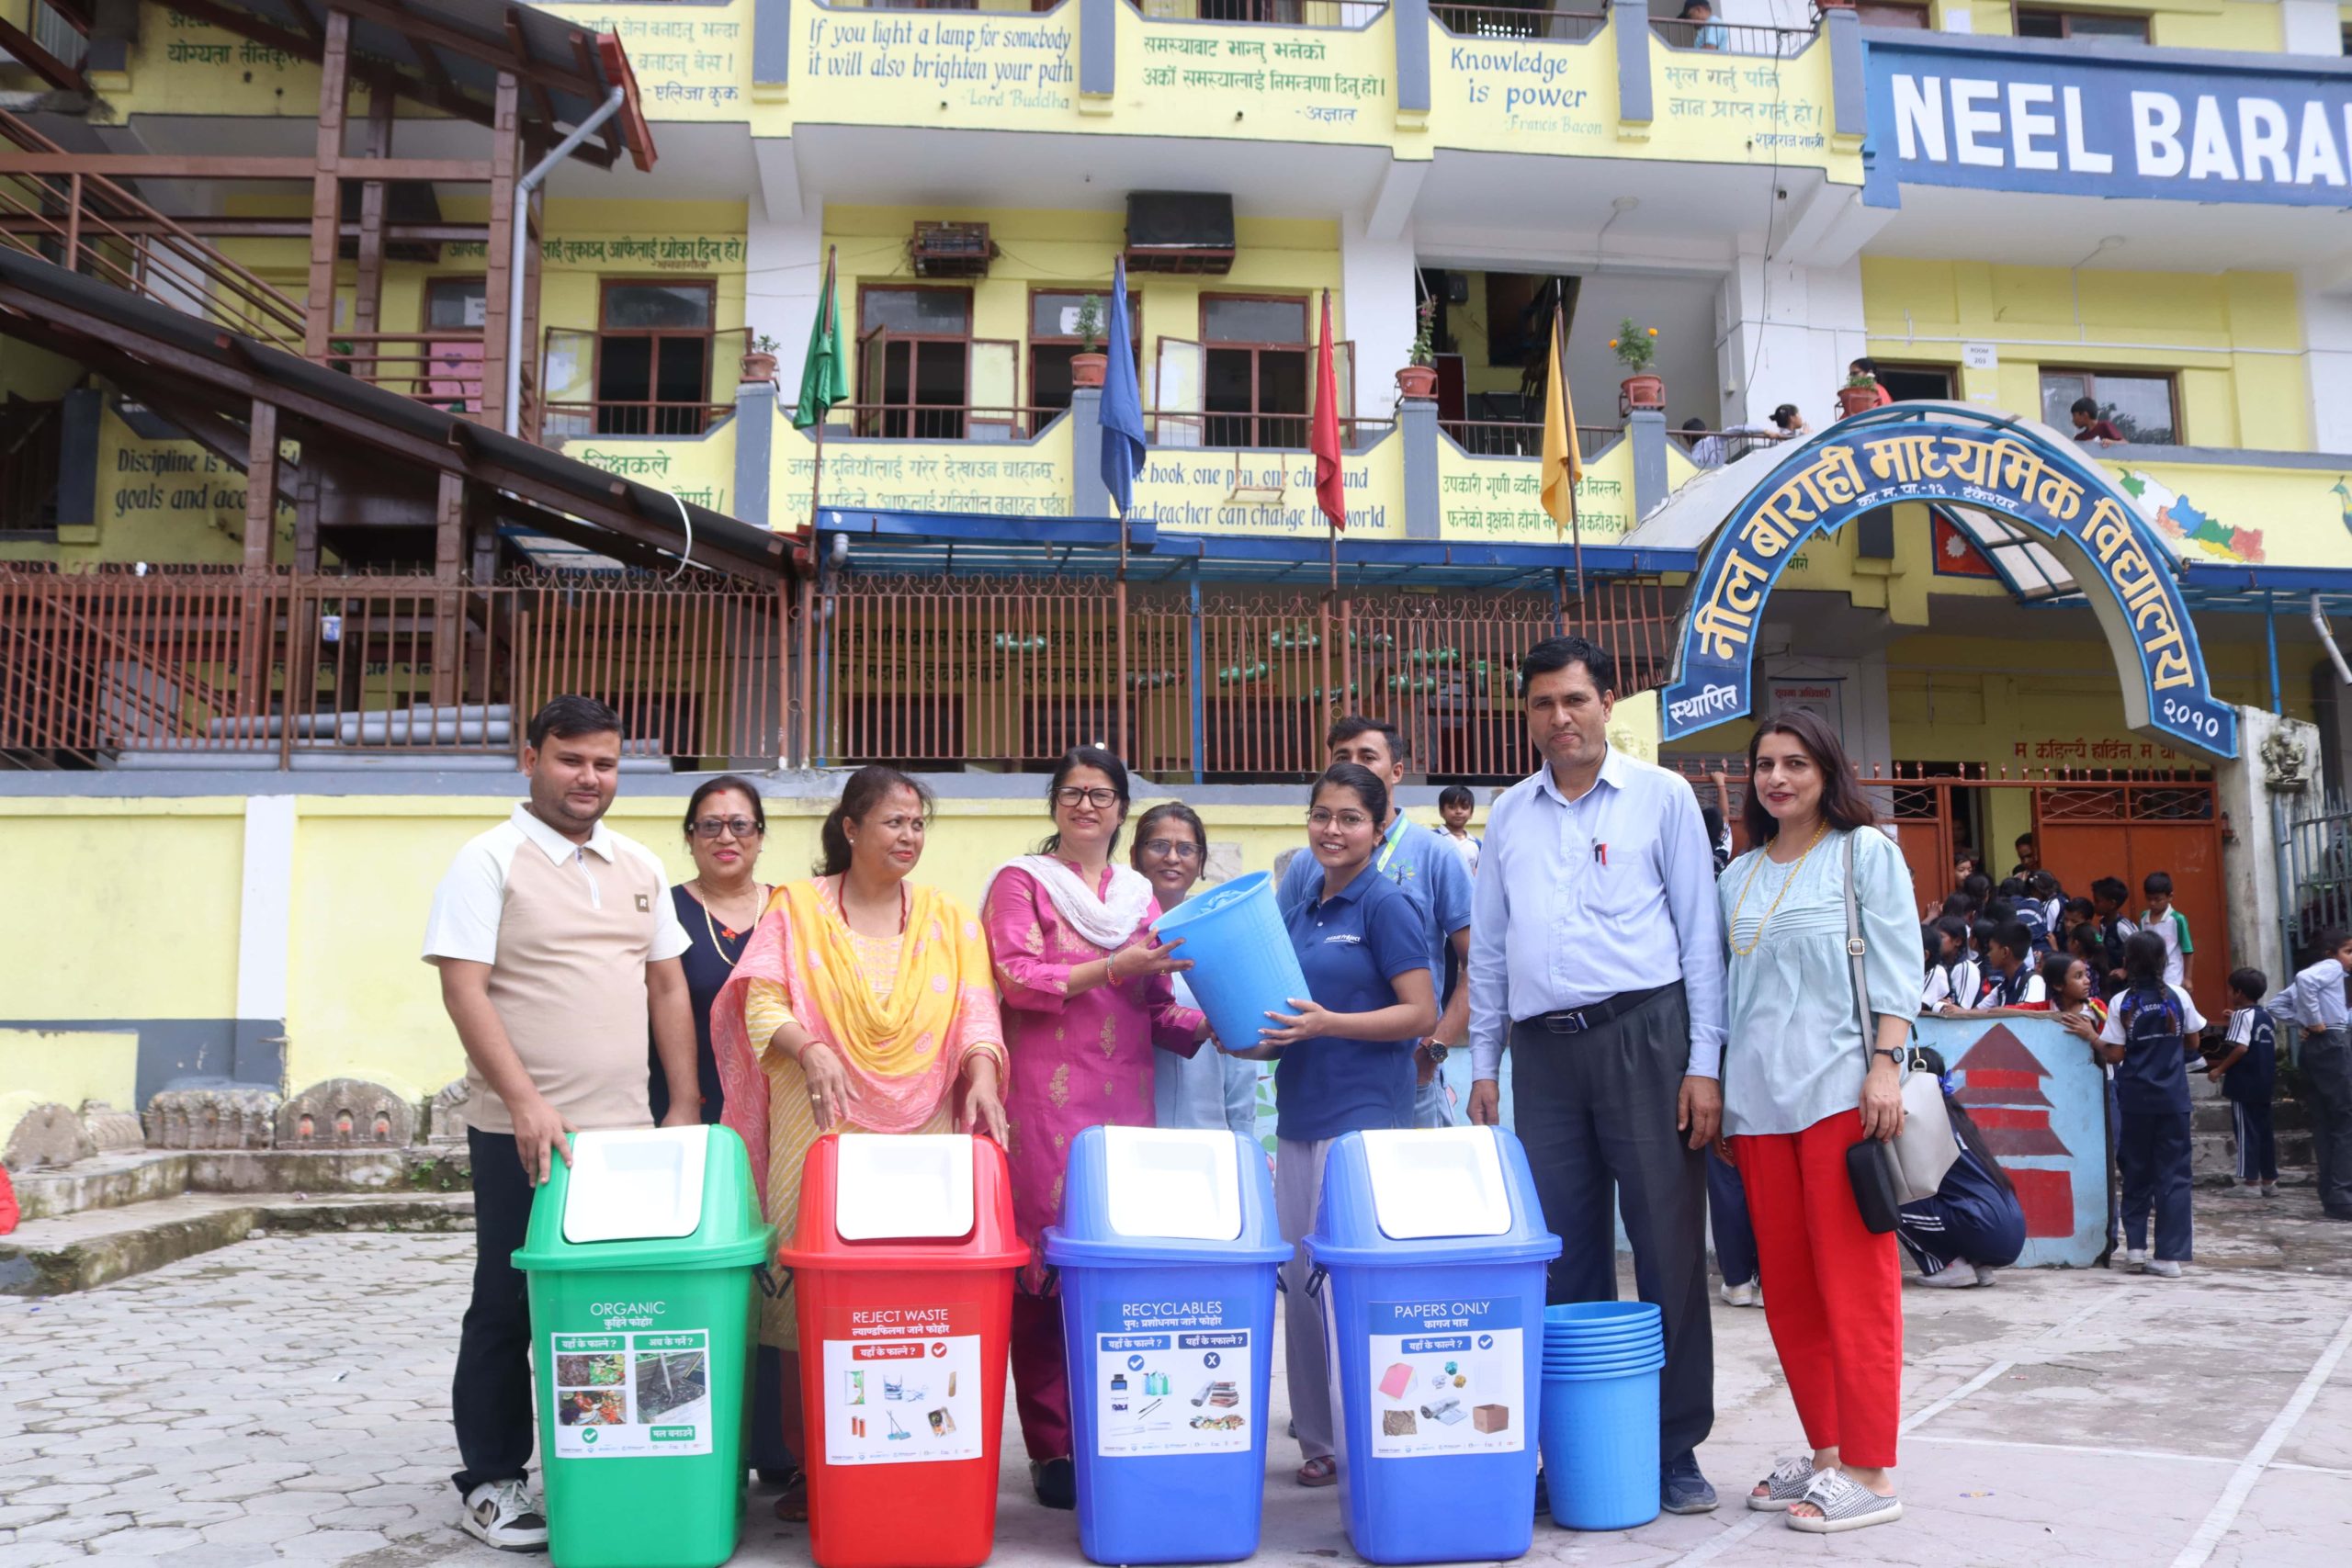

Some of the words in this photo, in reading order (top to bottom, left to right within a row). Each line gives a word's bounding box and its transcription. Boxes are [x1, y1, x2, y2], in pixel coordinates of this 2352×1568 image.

[809, 18, 828, 49] If
[831, 24, 865, 48] you
[872, 19, 912, 50] light
[919, 27, 929, 45] a
[935, 21, 975, 53] lamp
[973, 24, 1000, 53] for
[1002, 25, 1071, 59] somebody
[808, 51, 821, 76] it
[828, 51, 863, 76] will
[870, 55, 905, 78] also
[912, 53, 987, 88] brighten
[993, 62, 1033, 90] your
[1038, 56, 1073, 88] path
[1450, 47, 1568, 83] Knowledge
[1009, 88, 1069, 109] Buddha
[1468, 78, 1490, 103] is
[1506, 86, 1587, 113] power
[1561, 117, 1602, 135] Bacon
[1892, 73, 2112, 174] NEEL
[2131, 90, 2352, 186] BARA
[117, 447, 197, 478] Discipline
[1193, 468, 1221, 485] one
[116, 482, 164, 517] goals
[171, 483, 209, 510] and
[1153, 501, 1211, 526] teacher
[1217, 506, 1246, 525] can
[1250, 502, 1306, 532] change
[1311, 505, 1331, 526] th
[1694, 548, 1770, 660] नील
[1740, 446, 1866, 559] बाराही
[1863, 435, 2086, 522] माध्यमिक
[2079, 497, 2195, 692] विद्यालय
[1668, 683, 1738, 727] स्थापित
[2163, 698, 2220, 739] २०१०
[590, 1301, 666, 1316] ORGANIC
[853, 1310, 901, 1323] REJECT
[905, 1309, 949, 1322] WASTE
[1122, 1301, 1222, 1317] RECYCLABLES
[1181, 1316, 1197, 1326] जाने
[1199, 1315, 1222, 1325] फोहोर
[1395, 1303, 1448, 1318] PAPERS
[1452, 1302, 1490, 1316] ONLY
[1423, 1319, 1450, 1329] कागज
[907, 1324, 924, 1335] जाने
[926, 1323, 950, 1334] फोहोर
